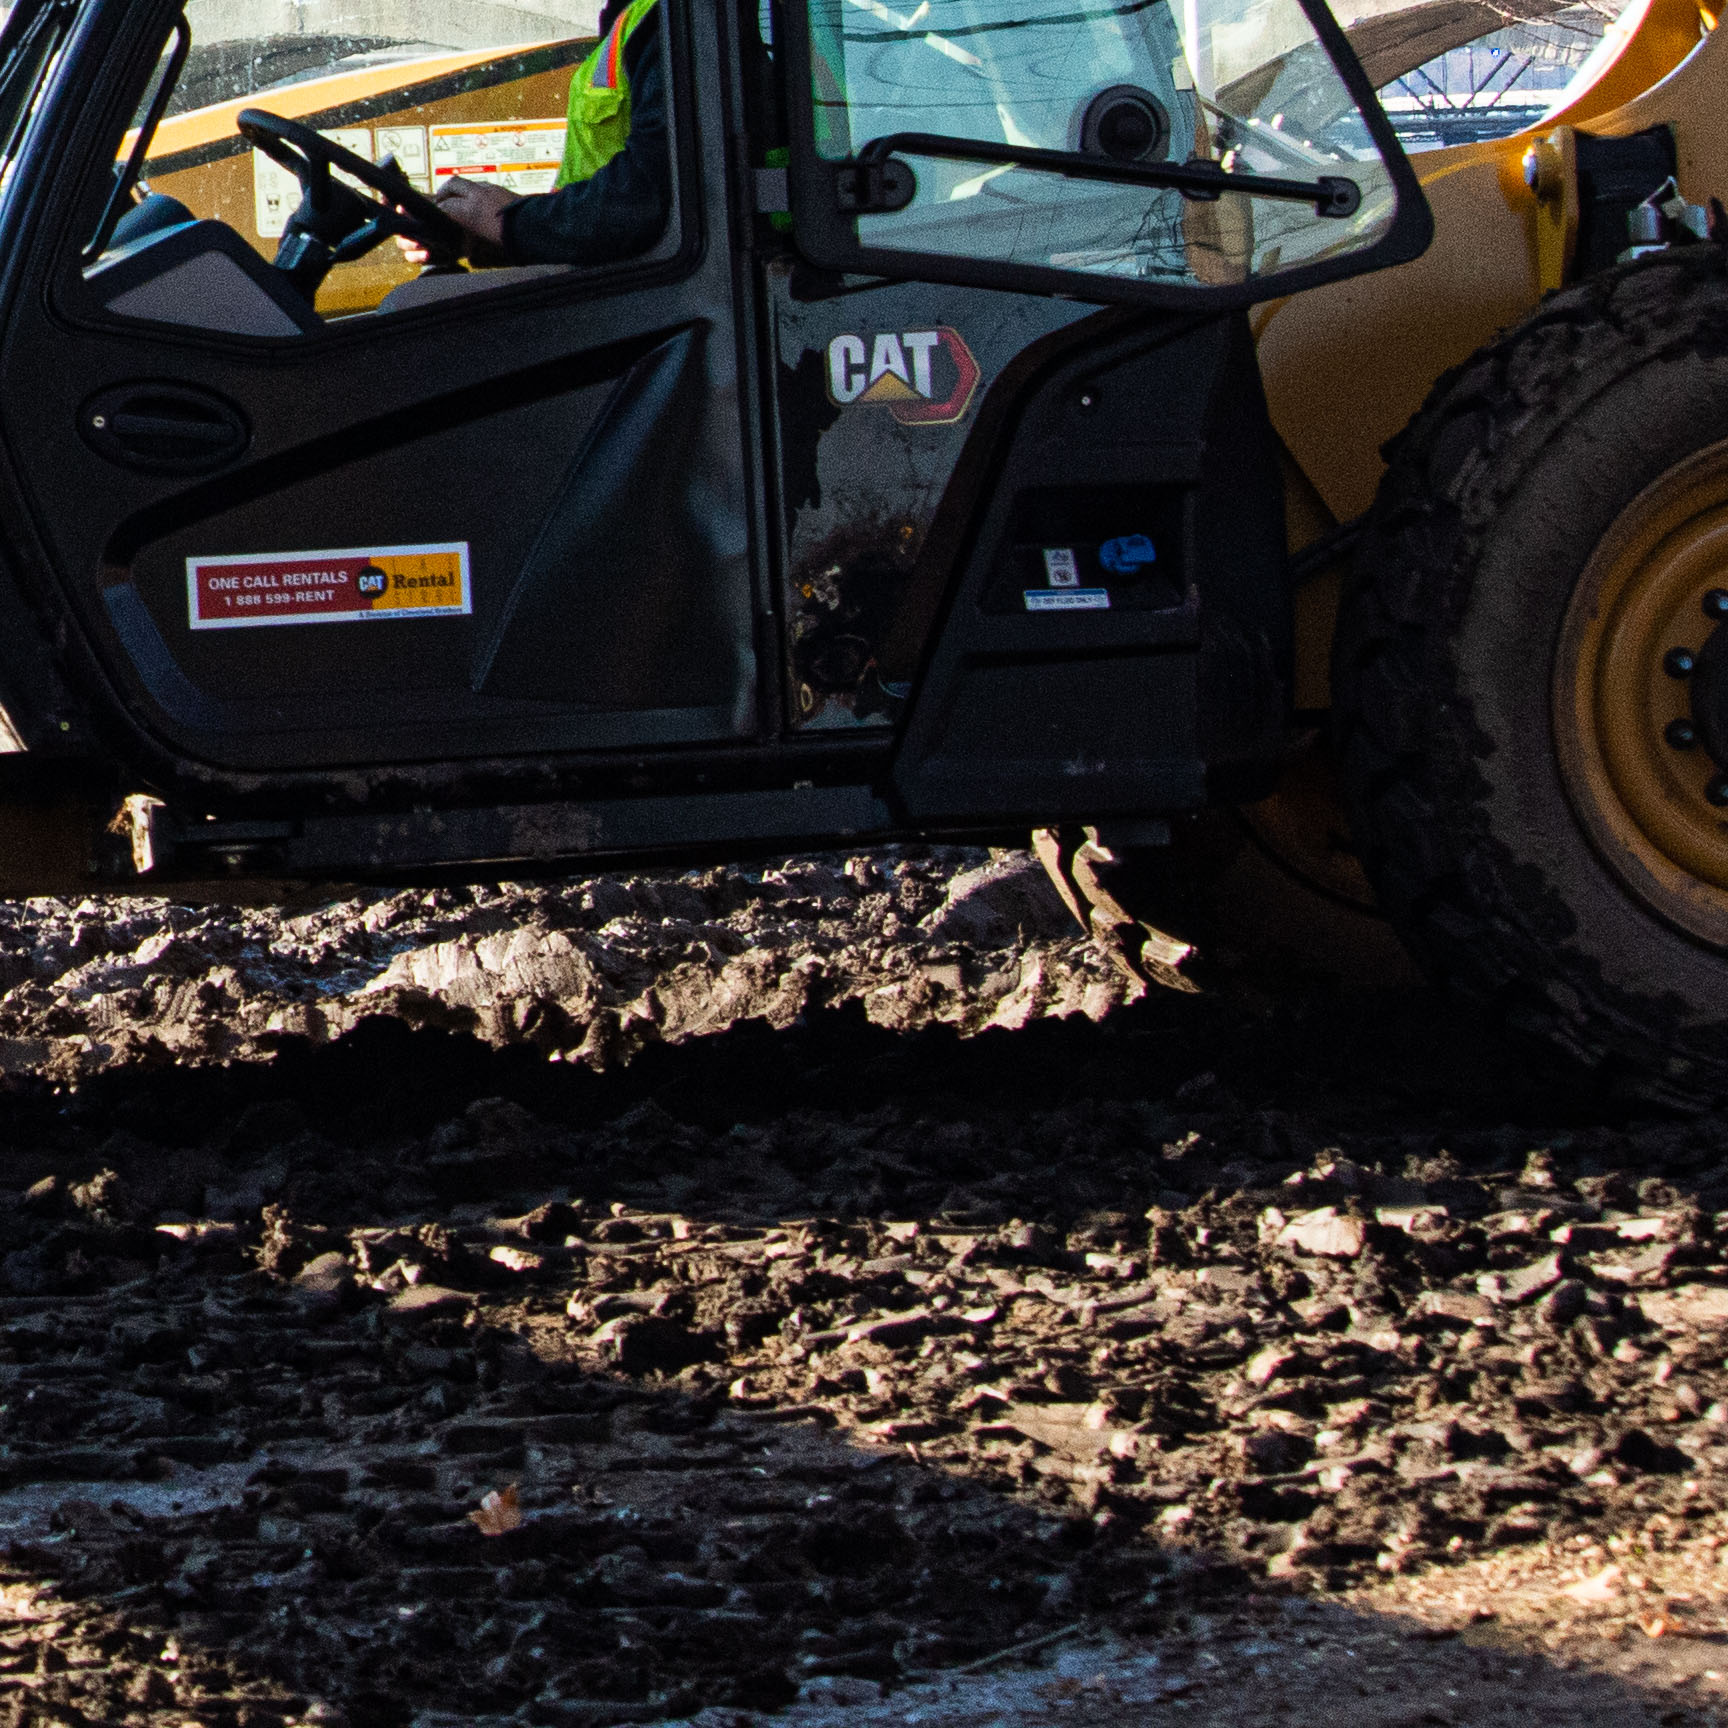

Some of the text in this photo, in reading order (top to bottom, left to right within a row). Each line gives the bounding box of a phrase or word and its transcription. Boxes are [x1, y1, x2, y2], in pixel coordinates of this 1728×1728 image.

[828, 332, 938, 404] CAT
[208, 571, 348, 591] ONE CALL RENTALS
[359, 571, 455, 591] CAT Rental
[224, 595, 232, 607] 1
